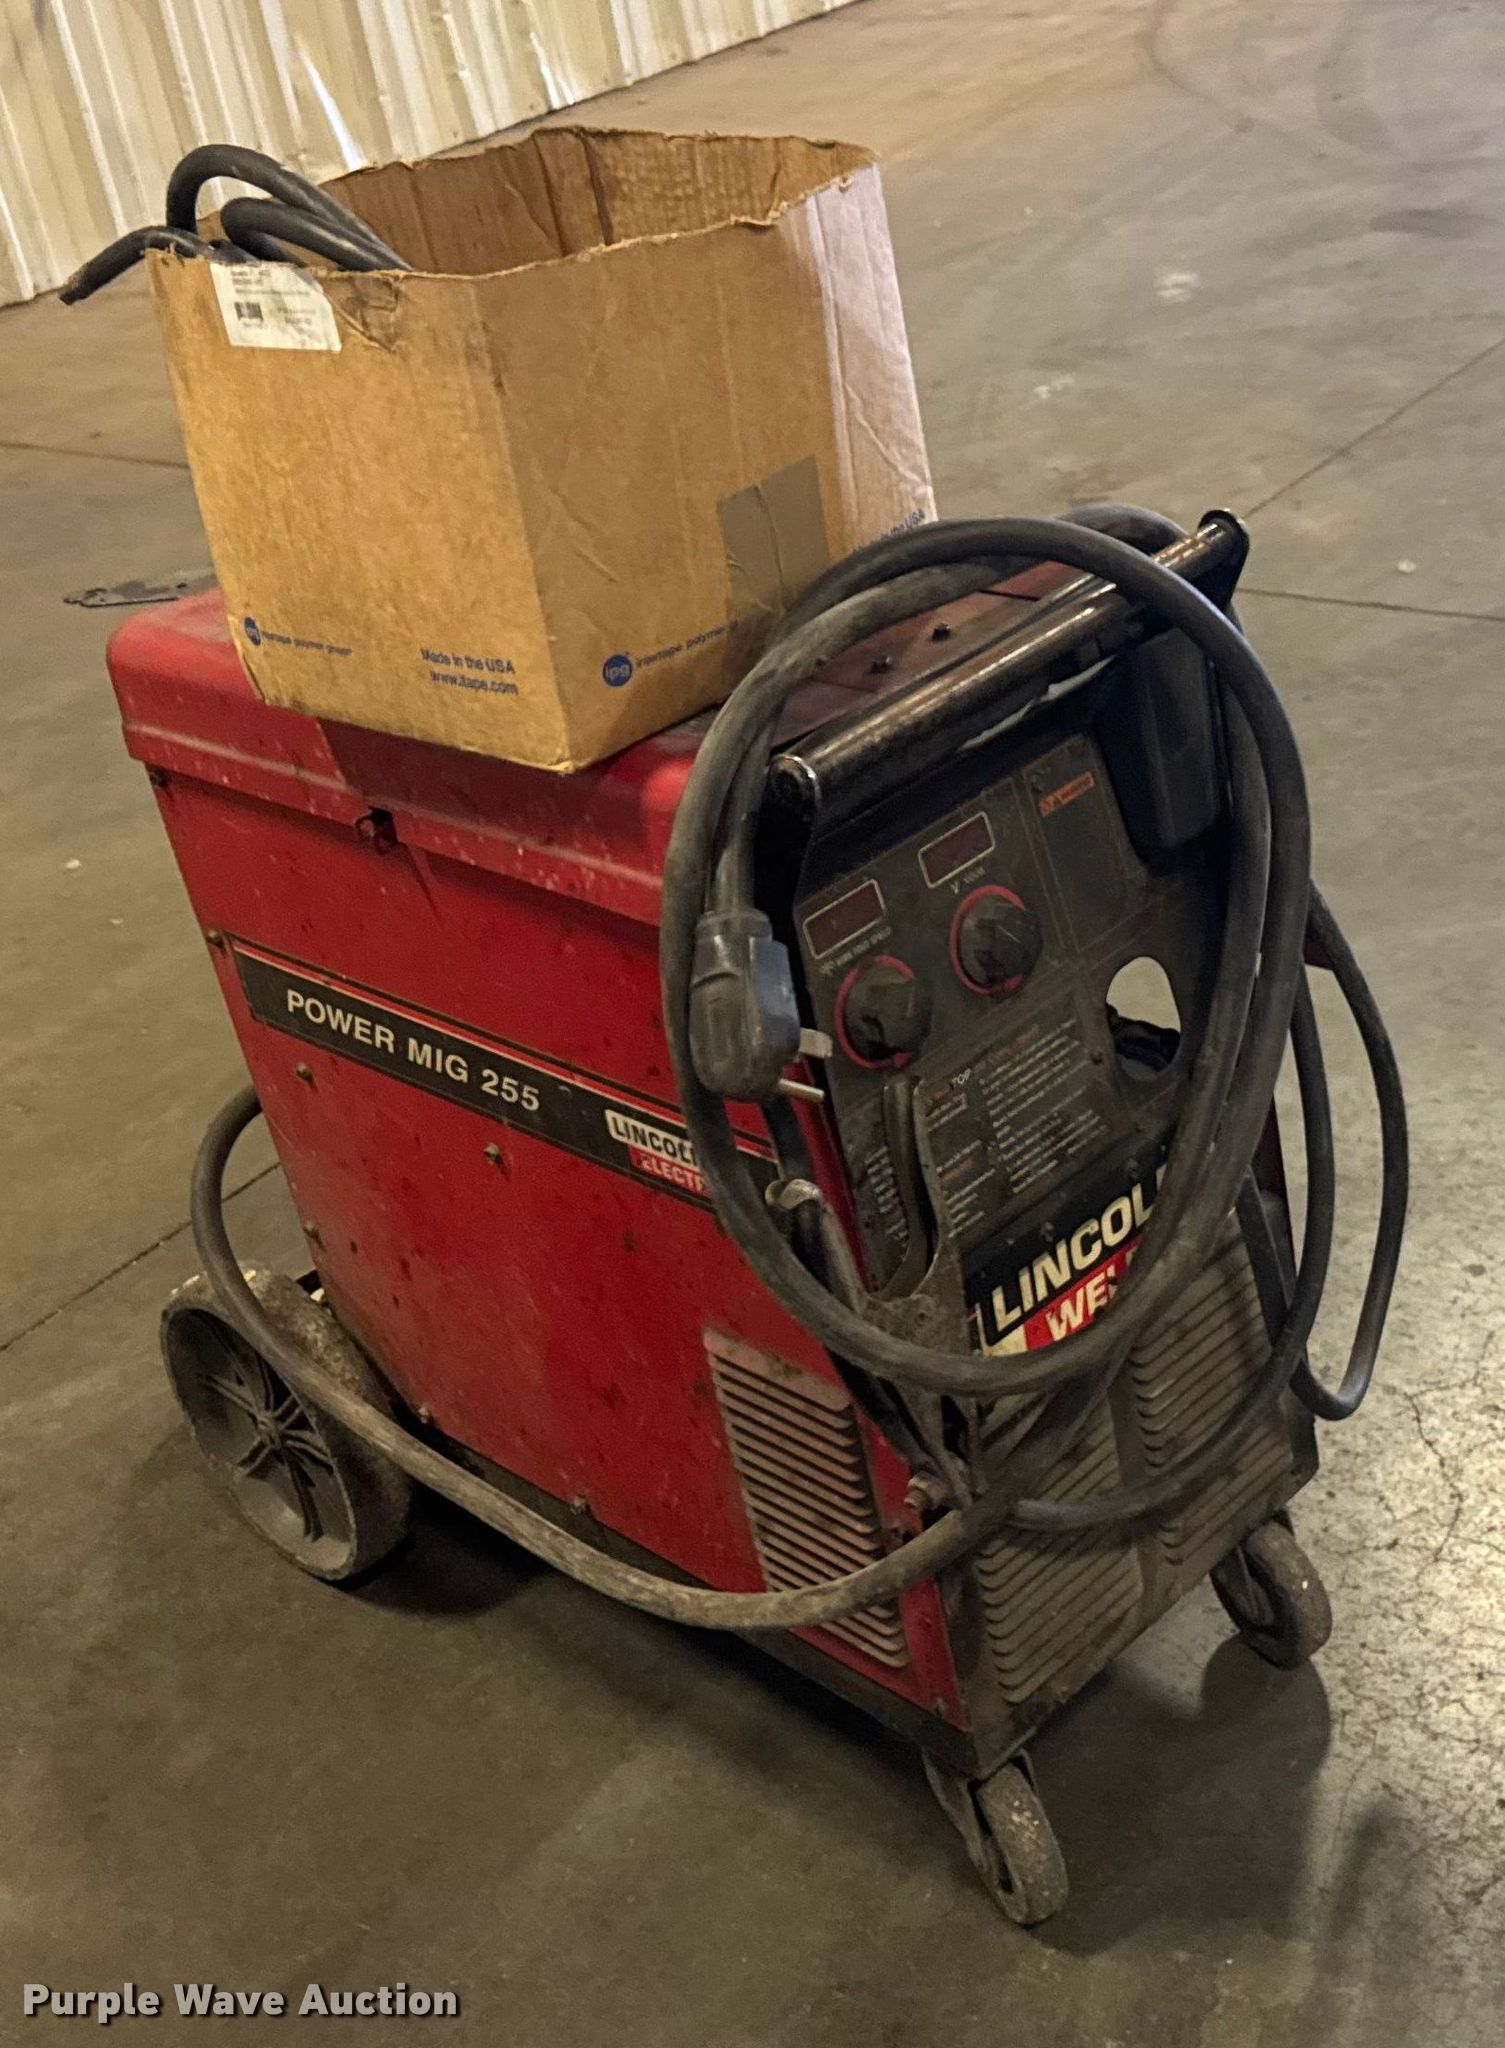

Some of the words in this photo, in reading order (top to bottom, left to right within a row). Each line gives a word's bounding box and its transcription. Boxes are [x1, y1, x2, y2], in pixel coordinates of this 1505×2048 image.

[420, 647, 452, 666] Made
[452, 652, 464, 667] in
[464, 655, 484, 671] the
[484, 657, 516, 676] USA
[286, 988, 397, 1055] POWER
[407, 1036, 471, 1084] MIG
[480, 1067, 541, 1112] 255
[991, 1163, 1167, 1333] LINCOL
